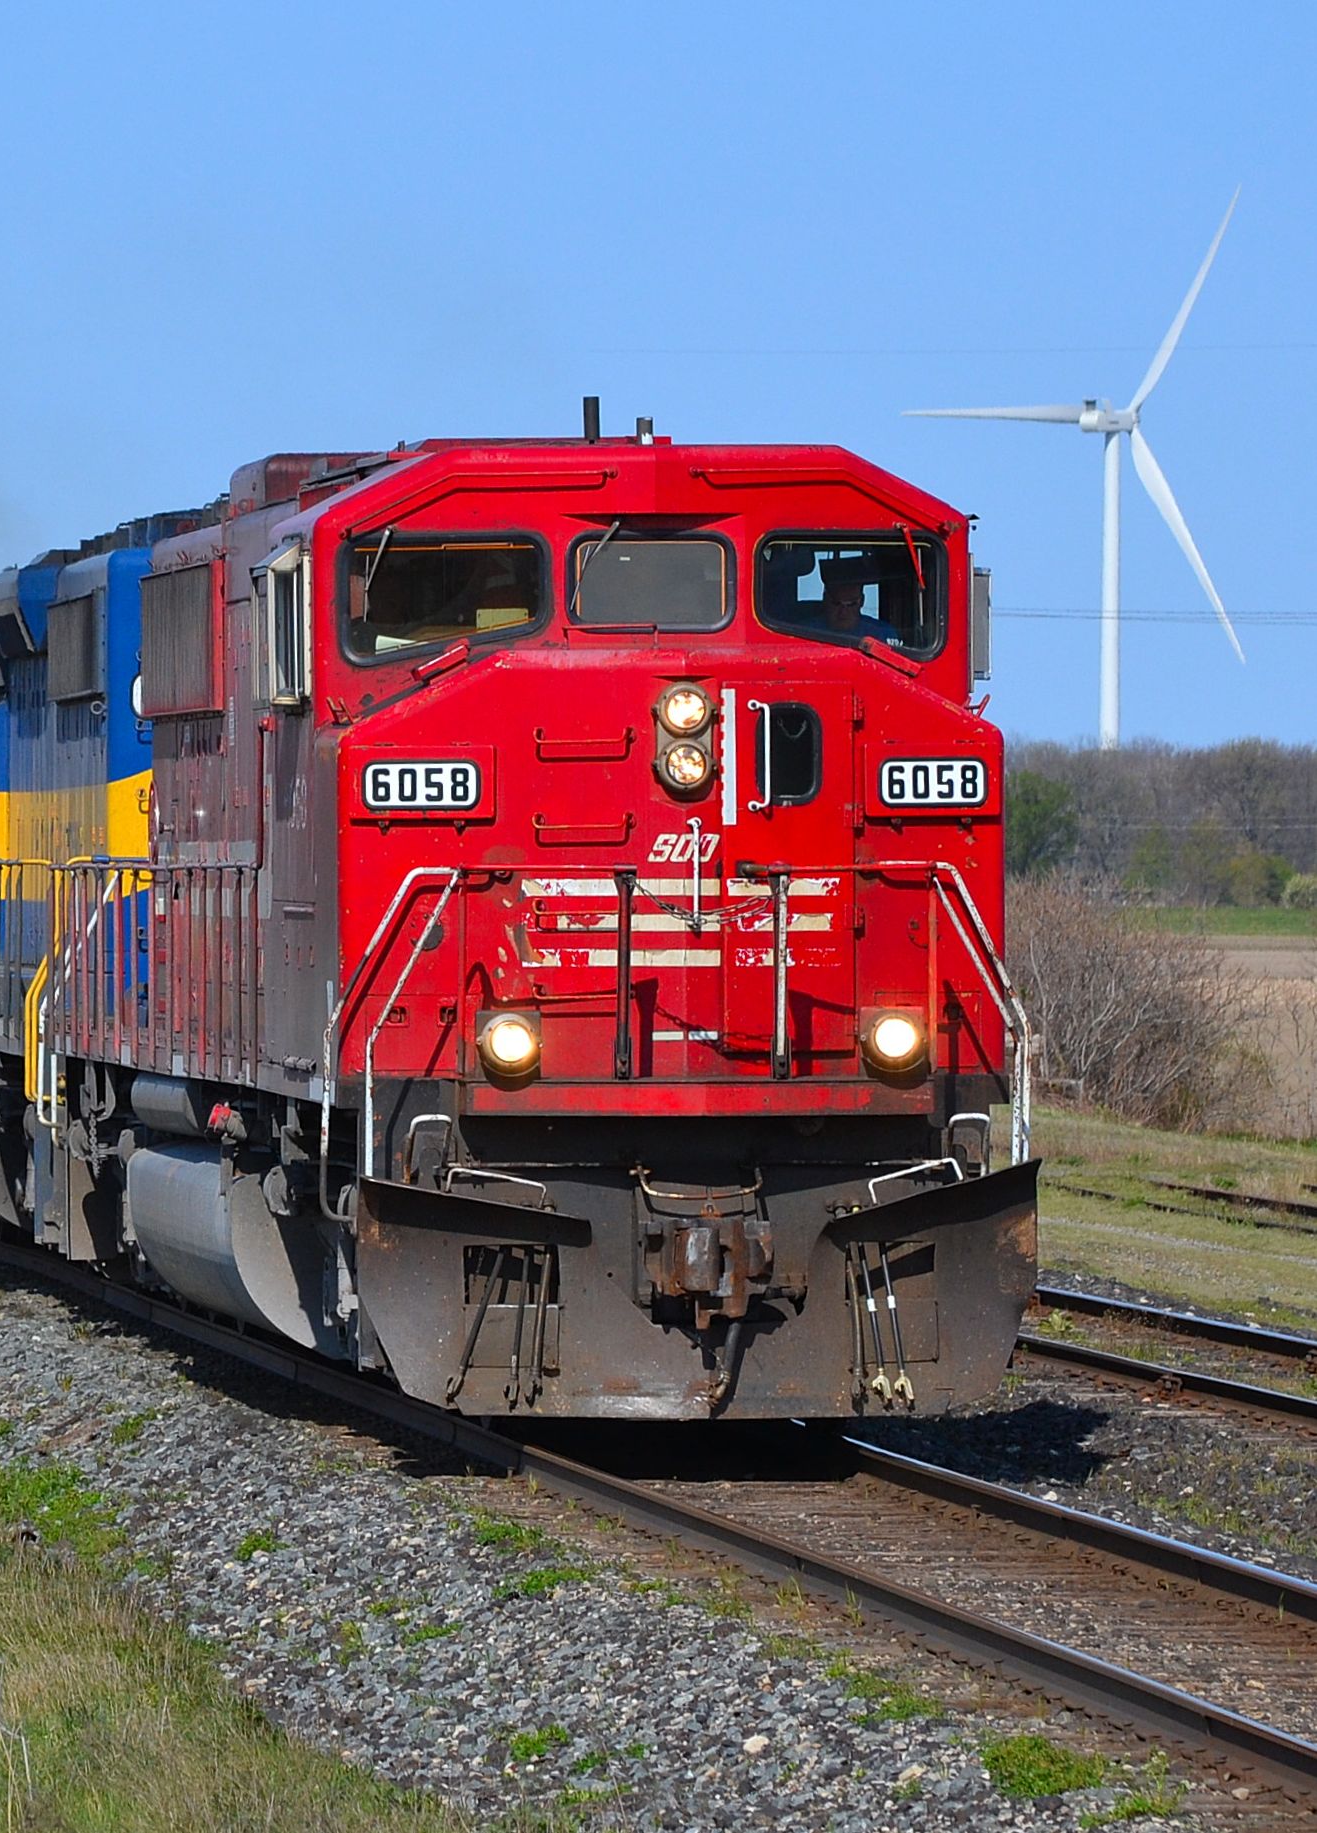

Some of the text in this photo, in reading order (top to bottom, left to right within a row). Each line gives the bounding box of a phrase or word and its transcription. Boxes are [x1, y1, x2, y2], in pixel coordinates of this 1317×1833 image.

[372, 768, 469, 802] 6058
[888, 765, 978, 799] 6058
[647, 833, 720, 862] SOO
